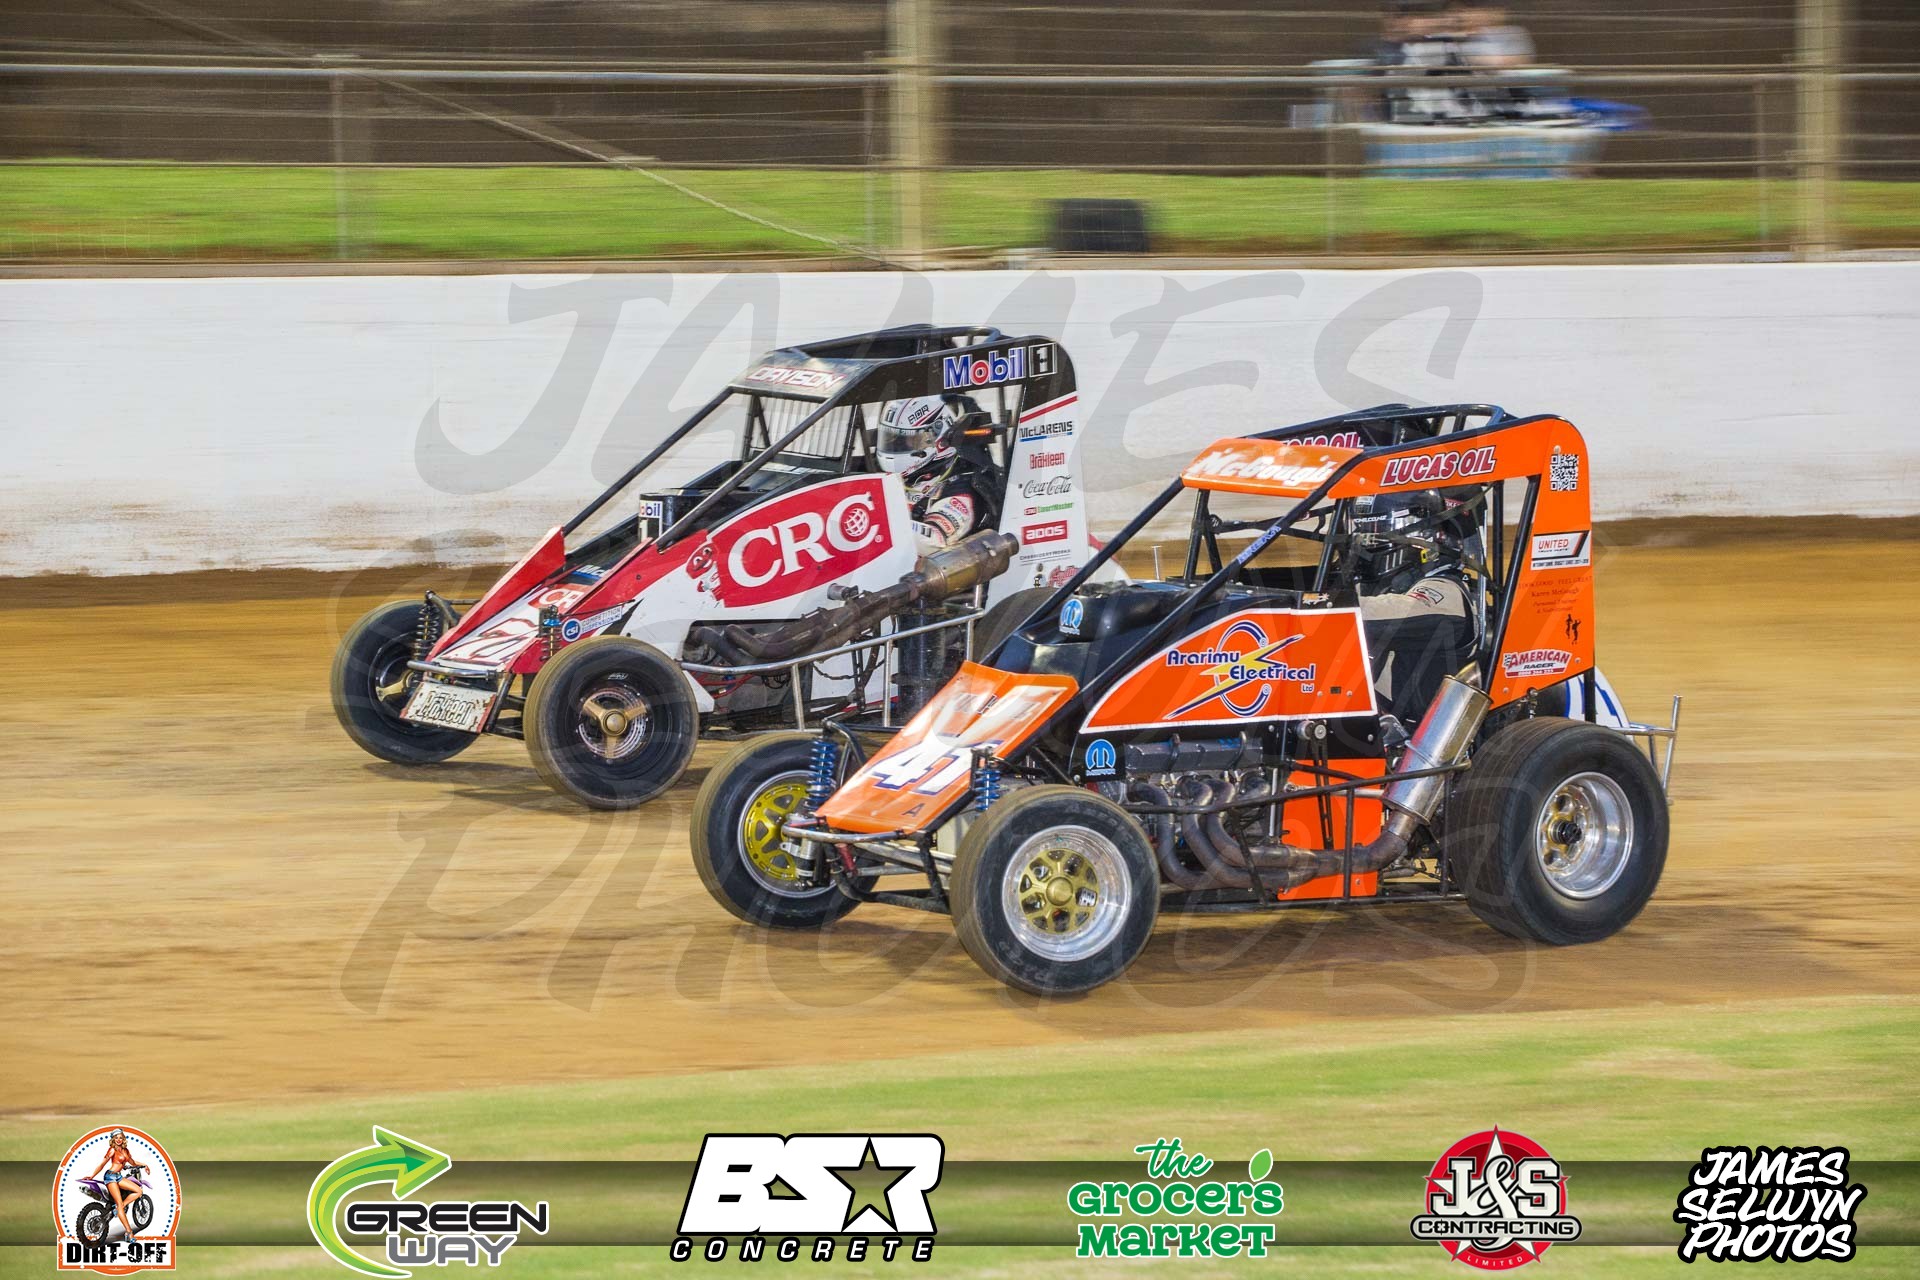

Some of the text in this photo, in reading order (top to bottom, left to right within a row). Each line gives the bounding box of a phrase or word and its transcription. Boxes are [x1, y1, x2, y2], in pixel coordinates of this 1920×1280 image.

[944, 347, 1026, 390] Mobil
[1019, 421, 1073, 438] McLARENS
[1380, 446, 1497, 487] LUCAS OIL
[728, 491, 880, 588] CRC
[1538, 539, 1570, 550] UNITED
[566, 624, 579, 637] csi
[1167, 649, 1240, 665] Ararimu
[1507, 650, 1571, 670] AMERICAN
[1229, 664, 1315, 681] Electrical
[1523, 662, 1556, 670] RACER
[1302, 684, 1315, 693] Ltd
